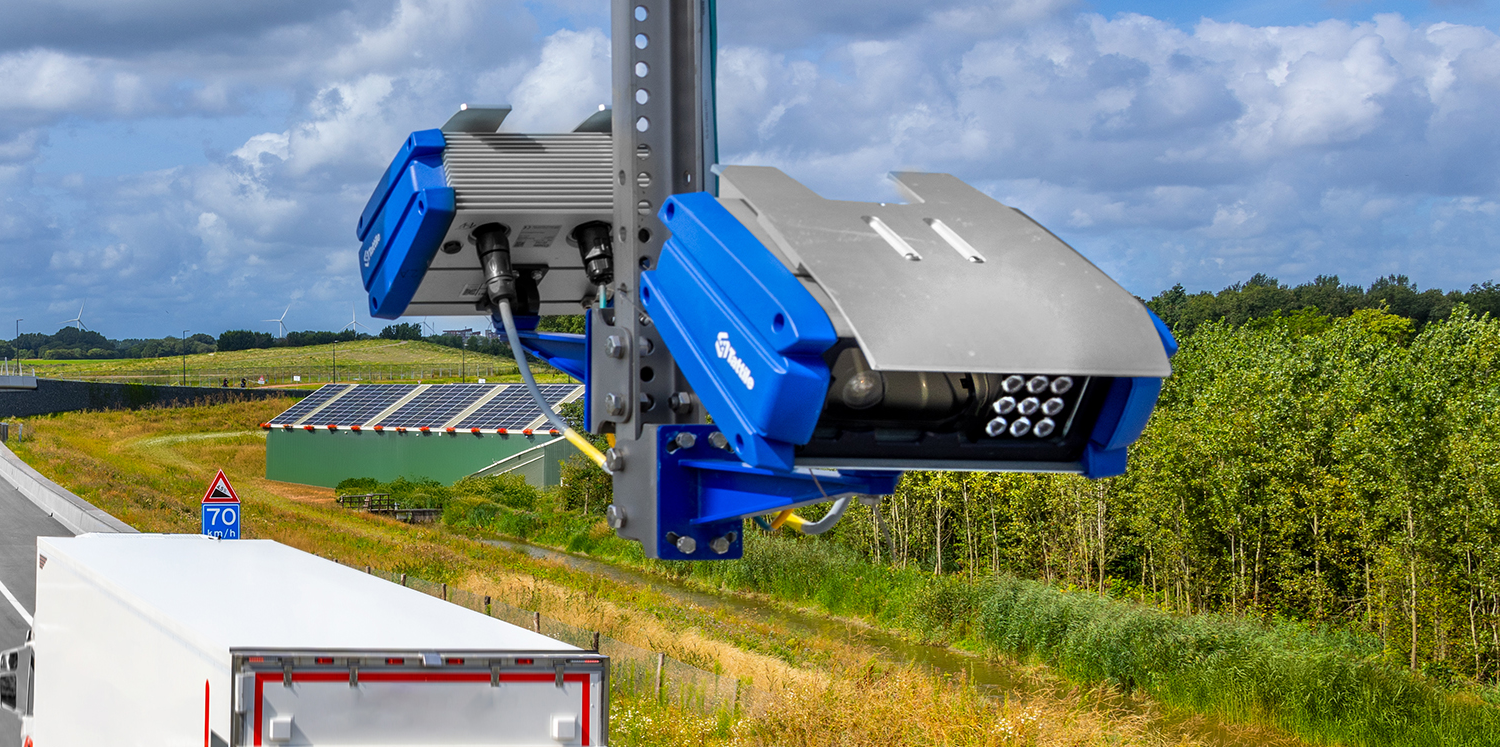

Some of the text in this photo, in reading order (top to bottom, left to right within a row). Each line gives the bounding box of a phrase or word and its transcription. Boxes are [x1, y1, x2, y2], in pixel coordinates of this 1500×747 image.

[726, 346, 755, 390] Tattile
[206, 507, 236, 526] 70
[207, 528, 236, 538] km/h
